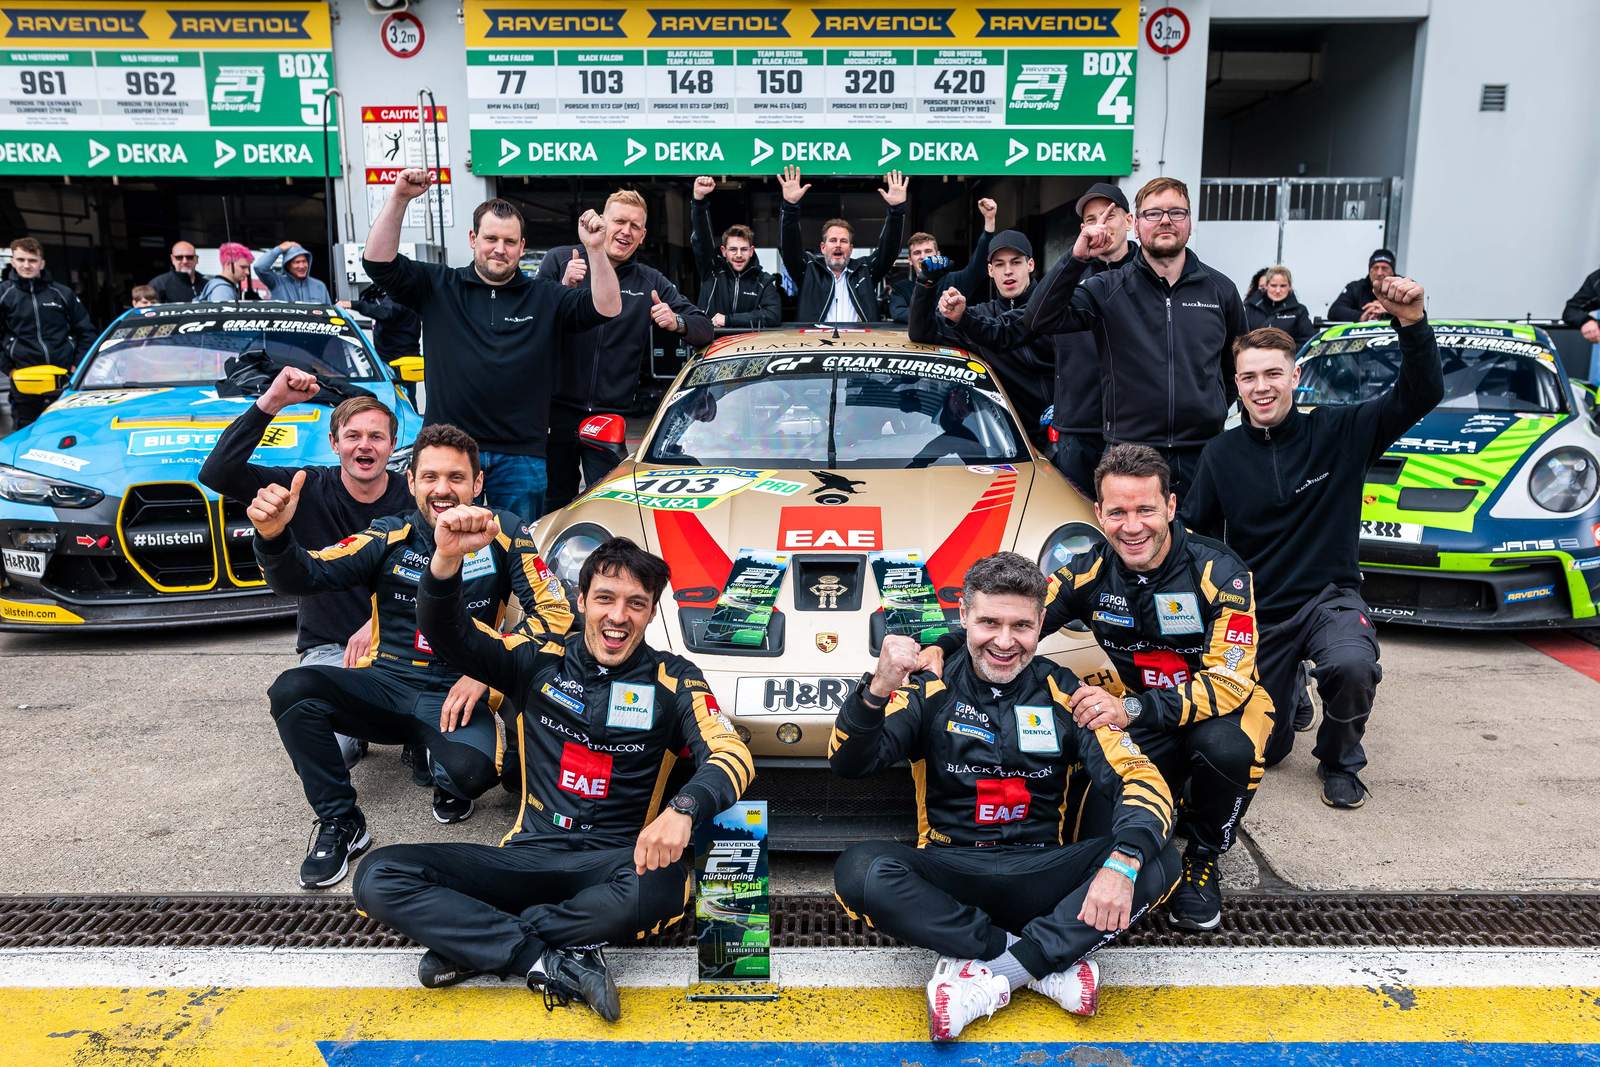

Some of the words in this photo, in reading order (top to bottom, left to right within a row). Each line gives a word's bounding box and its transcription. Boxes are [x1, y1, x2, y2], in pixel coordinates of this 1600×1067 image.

[17, 16, 134, 32] RAVENOL
[181, 16, 298, 33] RAVENOL
[497, 16, 613, 32] RAVENOL
[661, 16, 777, 32] RAVENOL
[825, 15, 942, 31] RAVENOL
[990, 15, 1107, 31] RAVENOL
[278, 54, 329, 78] BOX
[1083, 52, 1133, 76] BOX
[20, 70, 67, 95] 961
[125, 71, 177, 96] 962
[497, 70, 527, 94] 77
[579, 70, 624, 94] 103
[667, 70, 713, 94] 148
[757, 70, 802, 94] 150
[845, 70, 895, 94] 320
[934, 70, 985, 94] 420
[299, 78, 332, 125] 5
[1009, 100, 1060, 111] nürburgring
[1097, 77, 1133, 124] 4
[117, 143, 189, 164] DEKRA
[243, 143, 313, 164] DEKRA
[528, 142, 599, 162] DEKRA
[655, 142, 725, 162] DEKRA
[782, 142, 851, 162] DEKRA
[908, 142, 979, 162] DEKRA
[1036, 142, 1106, 162] DEKRA
[159, 308, 218, 317] BLACK
[238, 307, 308, 315] FALCON
[222, 320, 269, 329] GRAN
[272, 320, 342, 333] TURISMO
[736, 341, 813, 353] BLACK
[841, 342, 938, 352] FALCON
[1462, 336, 1543, 355] TURISMO
[822, 356, 887, 368] GRAN
[889, 358, 979, 382] TURISMO
[874, 368, 916, 376] DRIVING
[917, 371, 976, 387] SIMULATOR
[636, 477, 720, 494] 103
[755, 479, 800, 494] PRO
[613, 493, 699, 509] DEKRA
[133, 532, 204, 547] #bilstein
[784, 530, 876, 548] EAE
[1507, 588, 1551, 601] RAVENOL
[1226, 629, 1253, 644] EAE
[1143, 669, 1188, 688] EAE
[763, 678, 847, 712] H&R
[613, 704, 645, 713] IDENTICA
[540, 715, 582, 740] BLACK
[593, 743, 645, 753] FALCON
[961, 726, 991, 739] MICHELIN
[946, 762, 992, 775] BLACK
[561, 769, 607, 796] EAE
[979, 804, 1027, 821] EAE
[703, 873, 754, 882] nürburgring
[733, 881, 762, 894] 52nd
